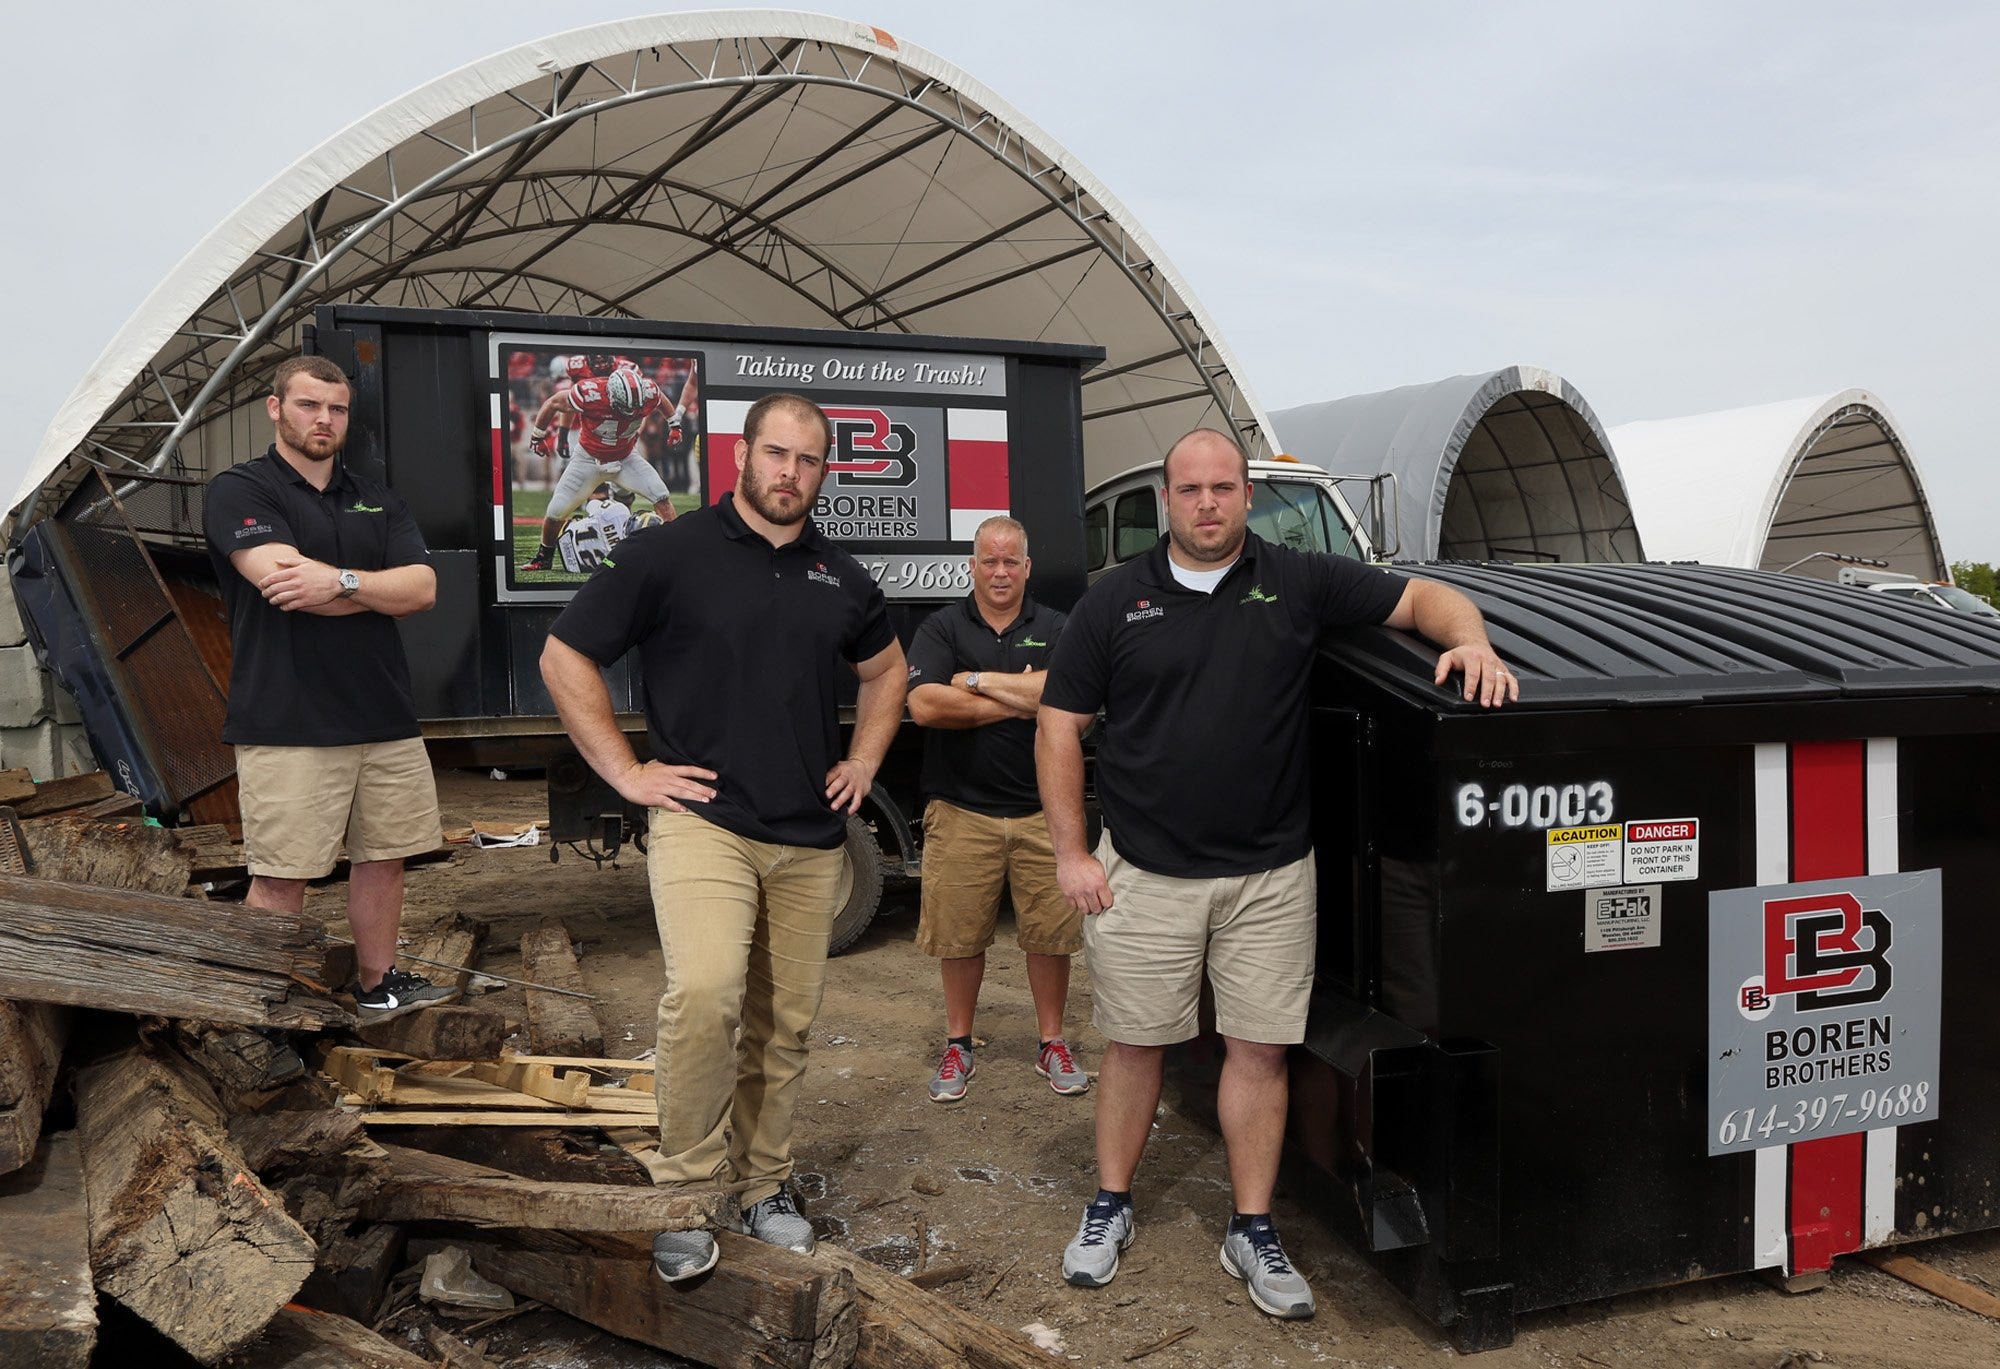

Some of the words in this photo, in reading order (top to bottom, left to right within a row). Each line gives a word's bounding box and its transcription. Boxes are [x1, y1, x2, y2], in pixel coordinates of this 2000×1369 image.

[736, 355, 815, 383] Taking
[822, 358, 865, 381] Out
[871, 361, 905, 382] the
[913, 363, 987, 386] Trash!
[812, 494, 918, 518] BOREN
[813, 520, 918, 538] BROTHERS
[859, 561, 972, 590] 7-9688
[1458, 781, 1613, 827] 6-0003
[1561, 828, 1617, 842] CAUTION
[1636, 825, 1689, 839] DANGER
[1631, 847, 1642, 855] DO
[1644, 846, 1660, 854] NOT
[1662, 845, 1683, 853] PARK
[1632, 856, 1659, 864] FRONT
[1661, 855, 1671, 863] OF
[1673, 854, 1691, 862] THIS
[1639, 865, 1683, 875] CONTAINER
[1597, 896, 1650, 919] E-Pak
[1765, 1015, 1892, 1062] BOREN
[1765, 1049, 1892, 1090] BROTHERS
[1719, 1081, 1930, 1145] 614-397-9688
